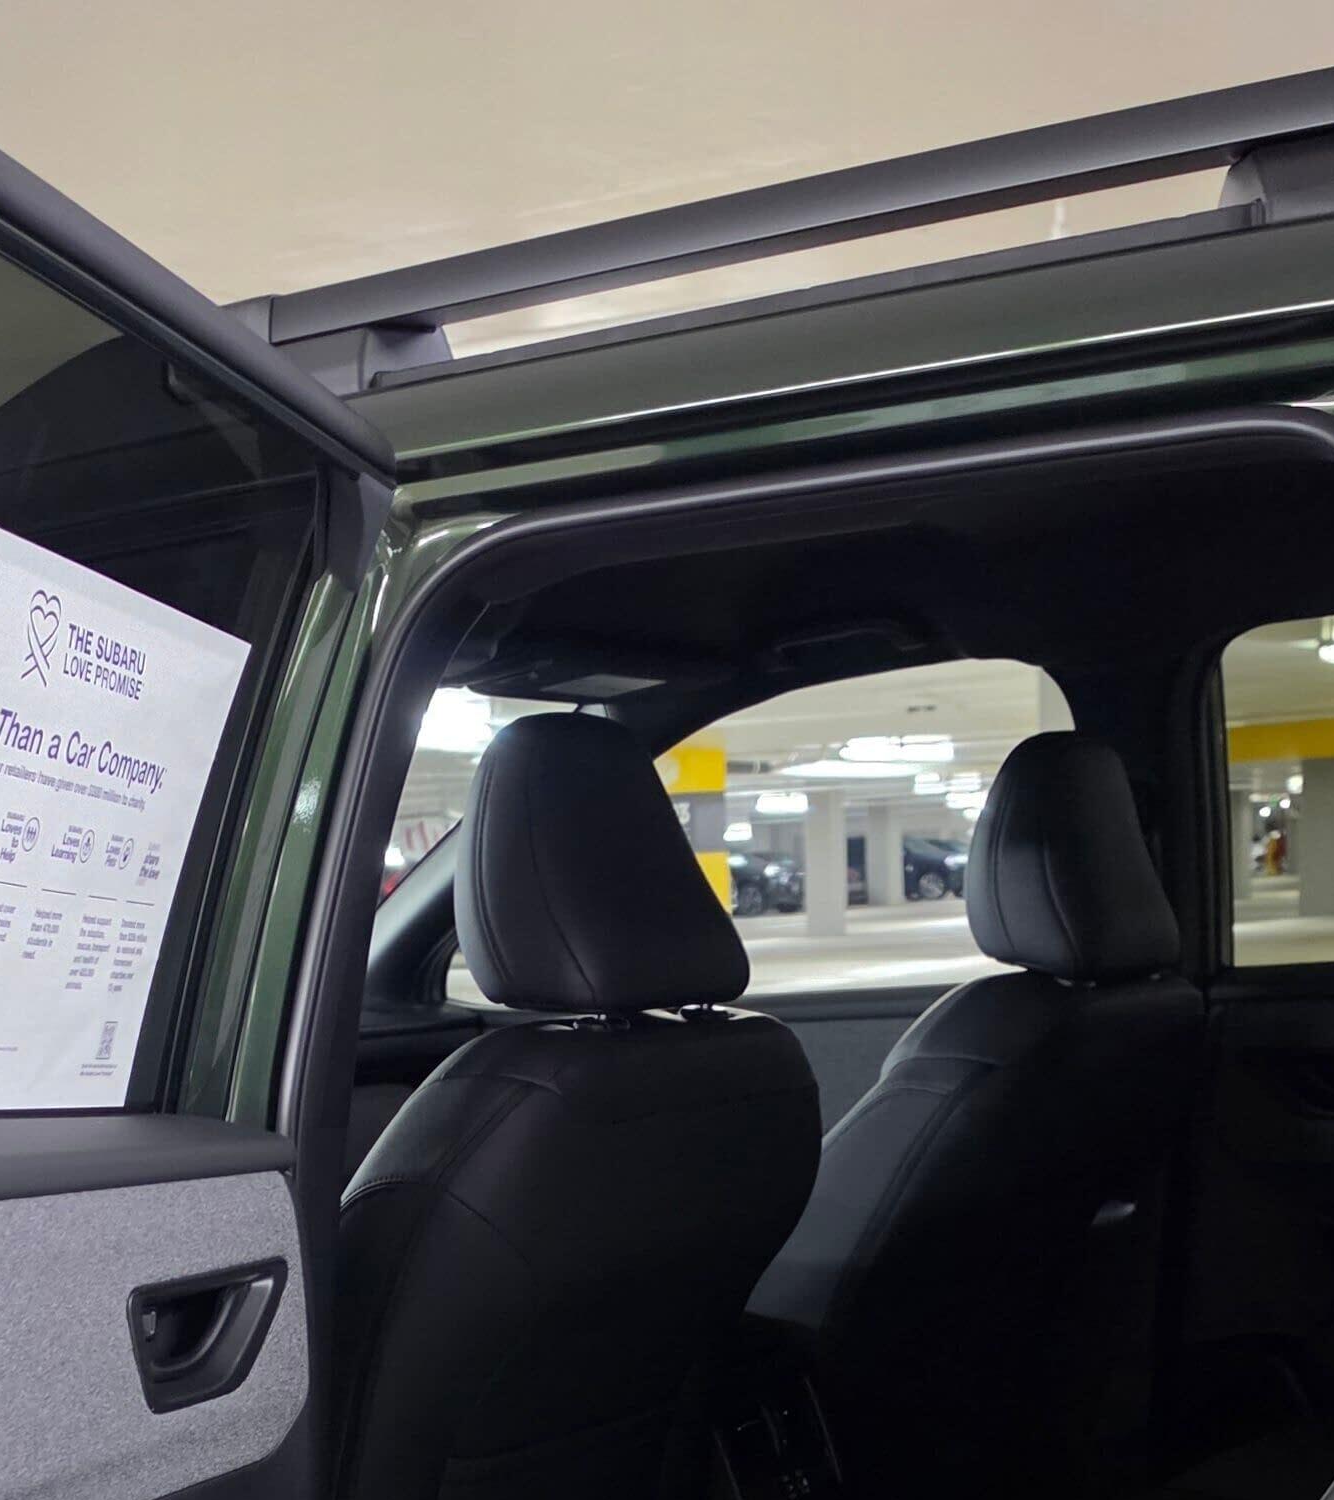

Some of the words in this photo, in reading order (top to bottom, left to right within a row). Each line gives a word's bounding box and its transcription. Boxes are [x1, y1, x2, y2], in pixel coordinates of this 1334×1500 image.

[68, 623, 93, 654] THE
[95, 636, 146, 675] SUBARU
[63, 653, 92, 682] LOVE
[94, 665, 143, 700] PROMISE
[47, 734, 62, 760] a
[65, 731, 96, 769] Car
[4, 763, 37, 783] retailers
[37, 770, 56, 787] have
[1, 819, 23, 836] Loves
[11, 837, 19, 848] to
[63, 832, 80, 848] Loves
[0, 848, 16, 863] Help
[51, 844, 77, 864] Learning
